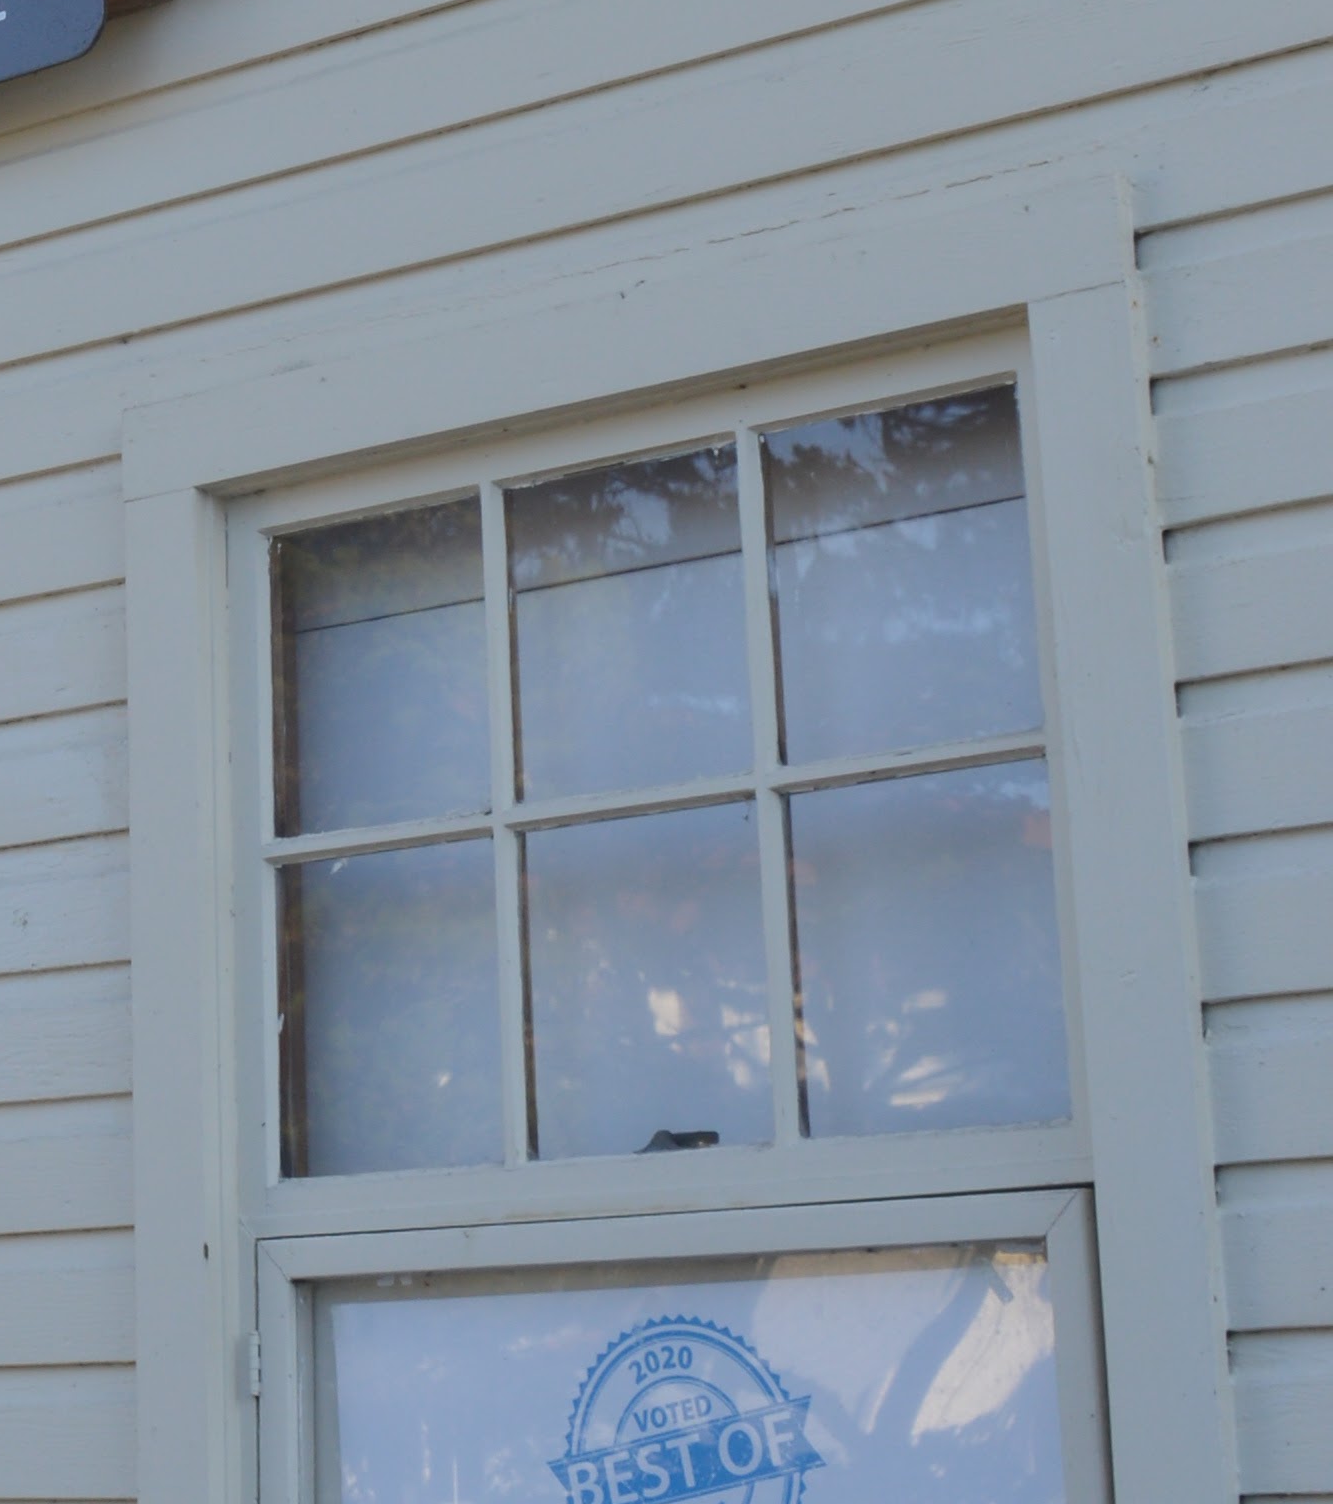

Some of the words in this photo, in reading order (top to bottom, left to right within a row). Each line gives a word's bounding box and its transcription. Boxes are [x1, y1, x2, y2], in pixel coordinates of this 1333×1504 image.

[628, 1346, 693, 1385] 2020
[633, 1395, 712, 1432] VOTED
[718, 1410, 795, 1477] OF
